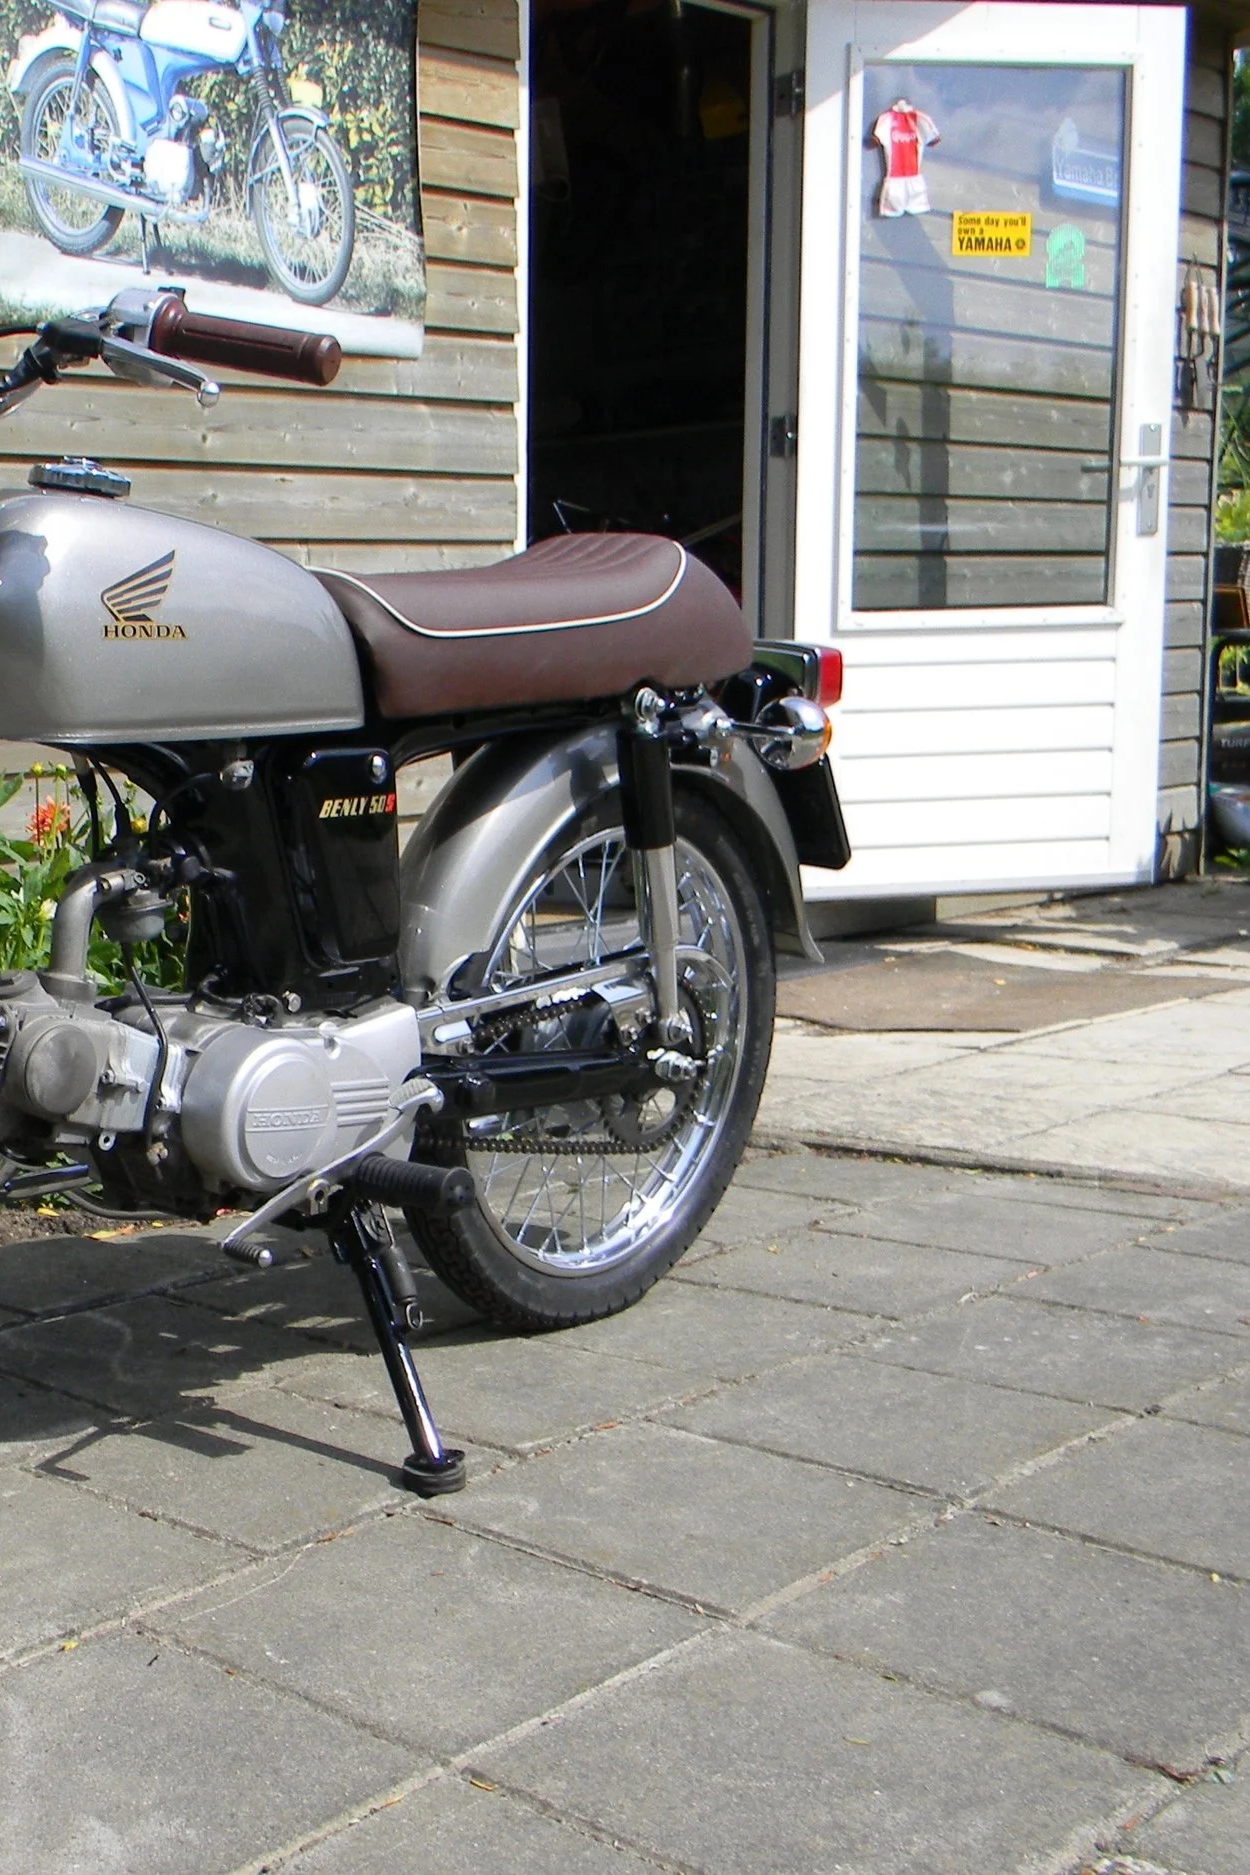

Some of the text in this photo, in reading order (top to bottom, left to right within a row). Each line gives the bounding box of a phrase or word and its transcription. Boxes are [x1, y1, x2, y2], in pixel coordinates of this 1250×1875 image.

[958, 216, 1027, 228] Some day you'll
[958, 236, 1012, 252] YAMAHA
[103, 625, 188, 639] HONDA
[319, 797, 368, 818] BENLY
[253, 1110, 319, 1128] HONDA
